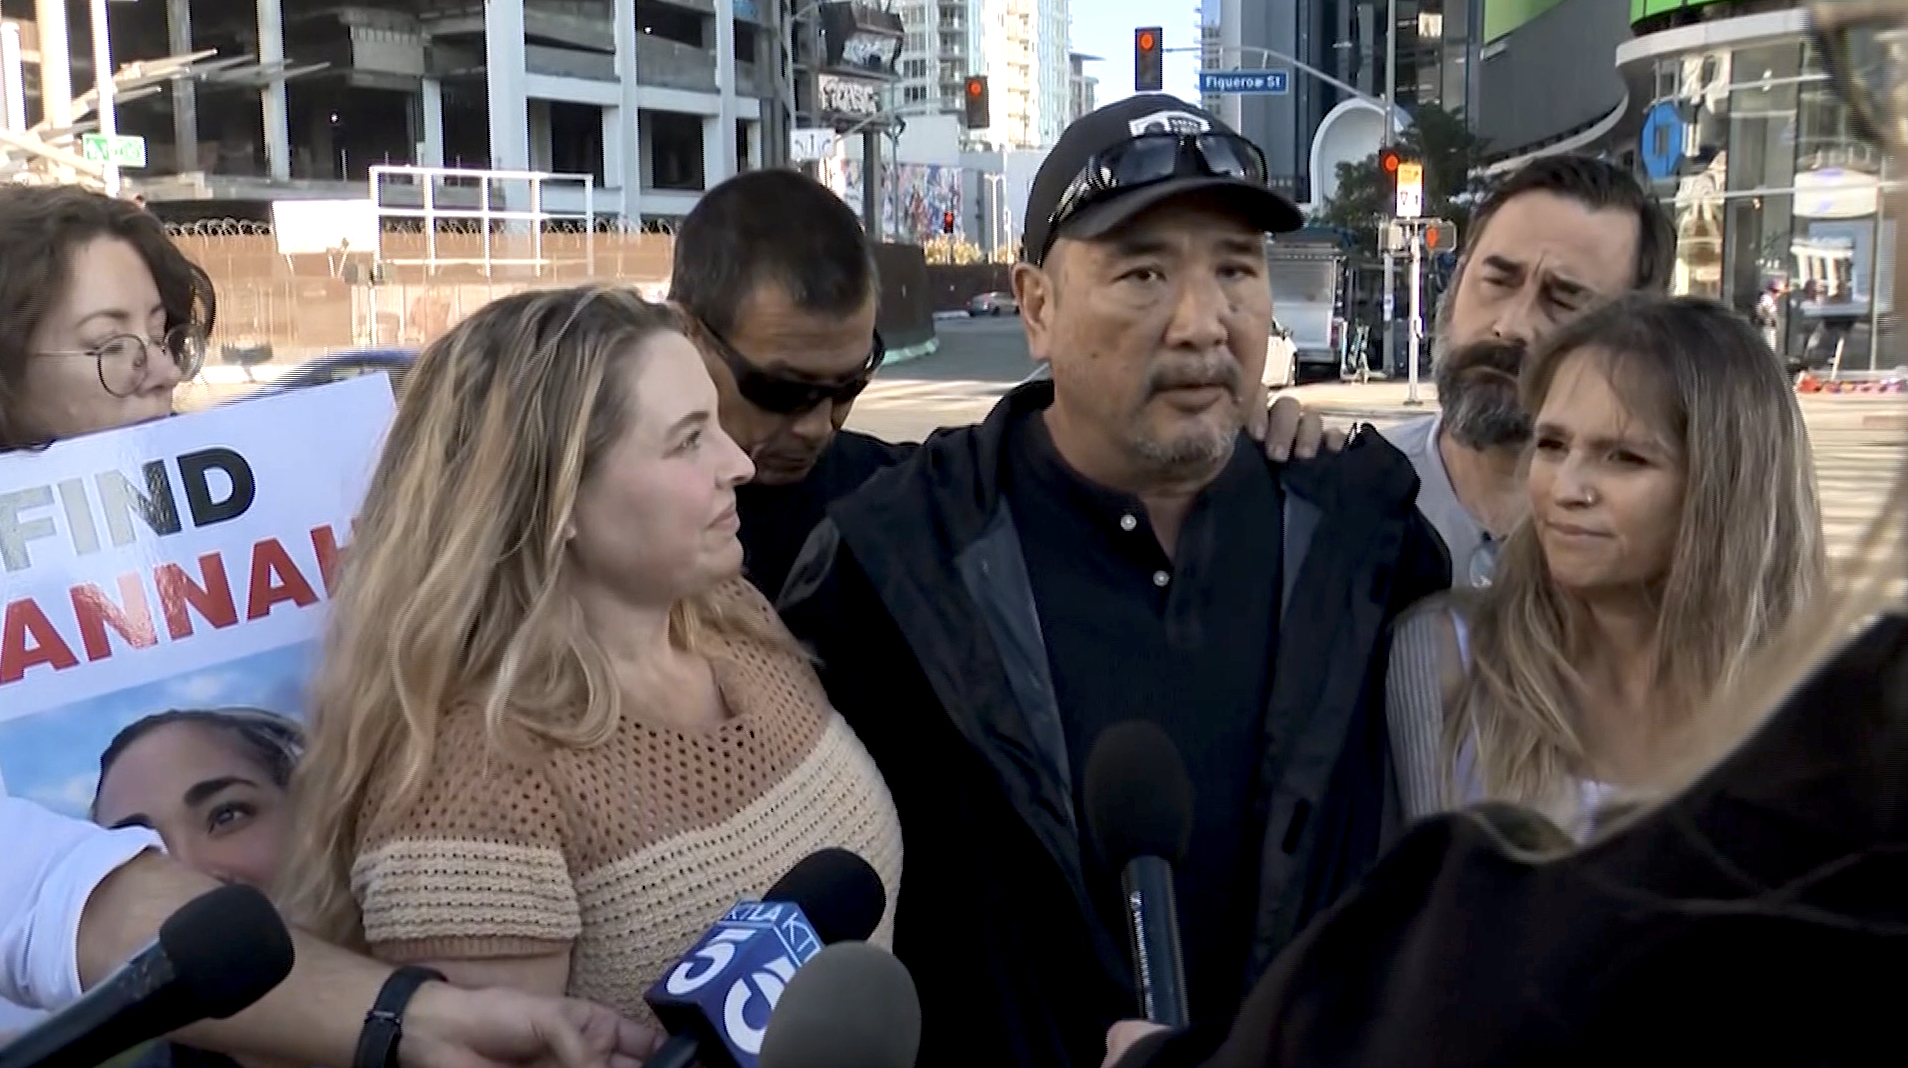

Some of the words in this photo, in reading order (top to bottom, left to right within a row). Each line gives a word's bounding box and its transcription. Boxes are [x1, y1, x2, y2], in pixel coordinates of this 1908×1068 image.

[1205, 75, 1265, 91] Figueroa
[1267, 75, 1281, 89] St
[0, 446, 256, 573] FIND
[666, 928, 757, 995] 5
